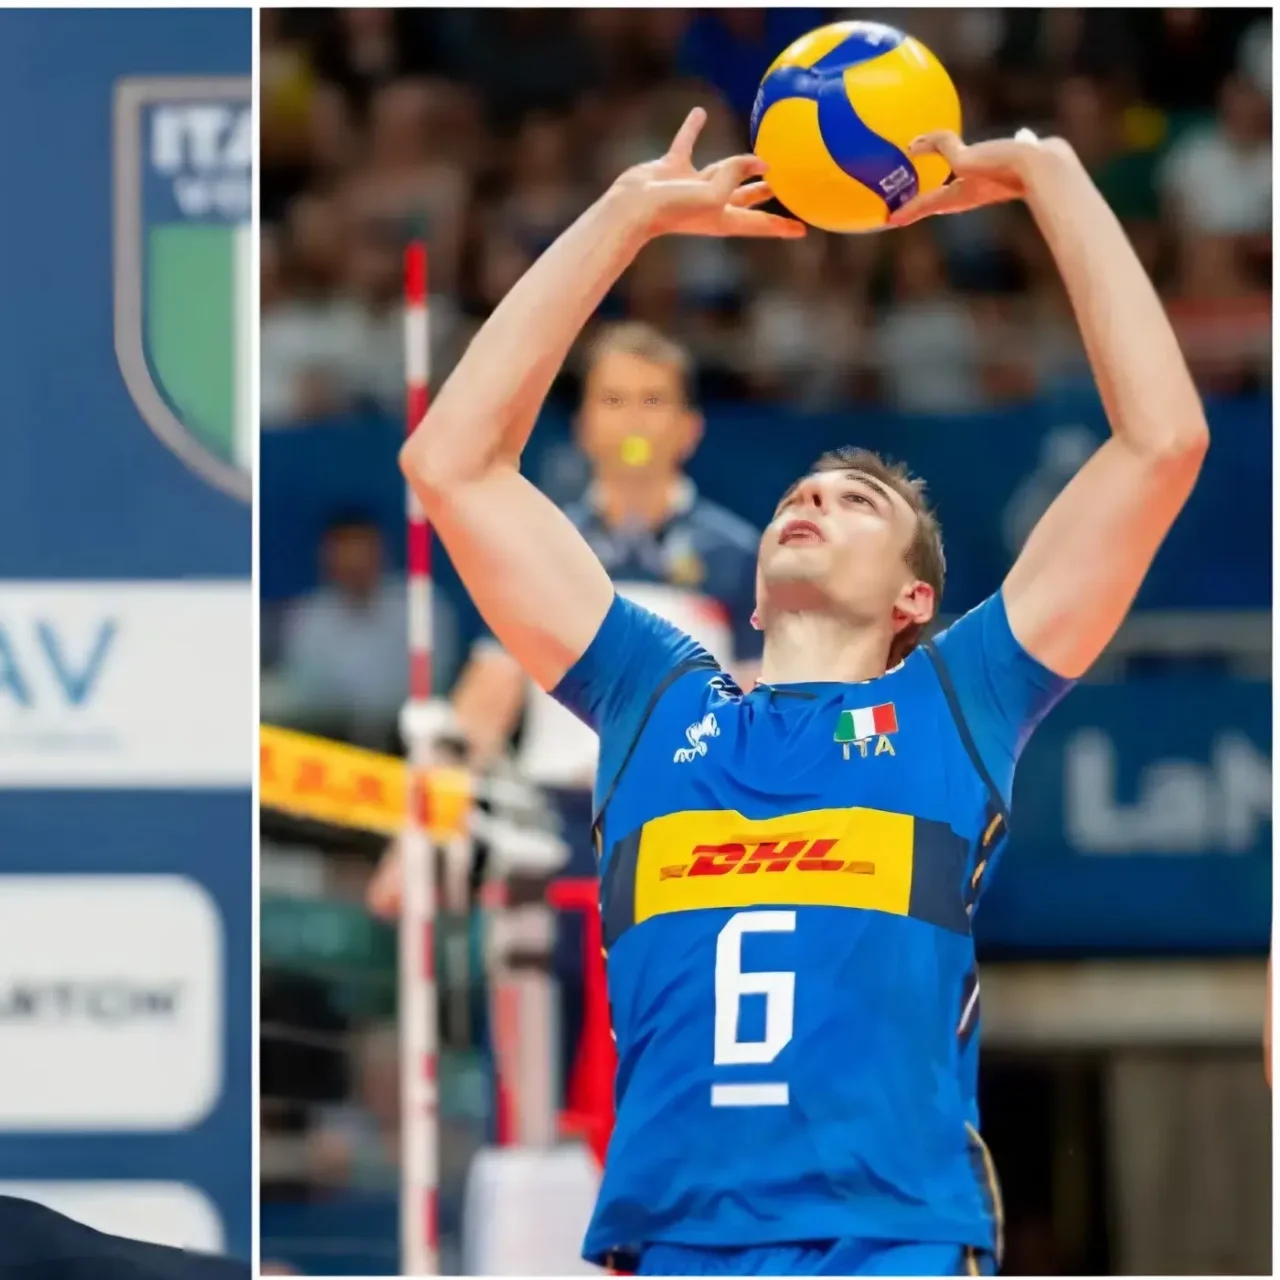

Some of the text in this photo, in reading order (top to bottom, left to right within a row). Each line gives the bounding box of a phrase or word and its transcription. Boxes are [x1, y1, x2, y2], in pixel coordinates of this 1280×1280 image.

[843, 735, 896, 760] ITA
[687, 838, 845, 877] DHL
[713, 910, 796, 1065] 6
